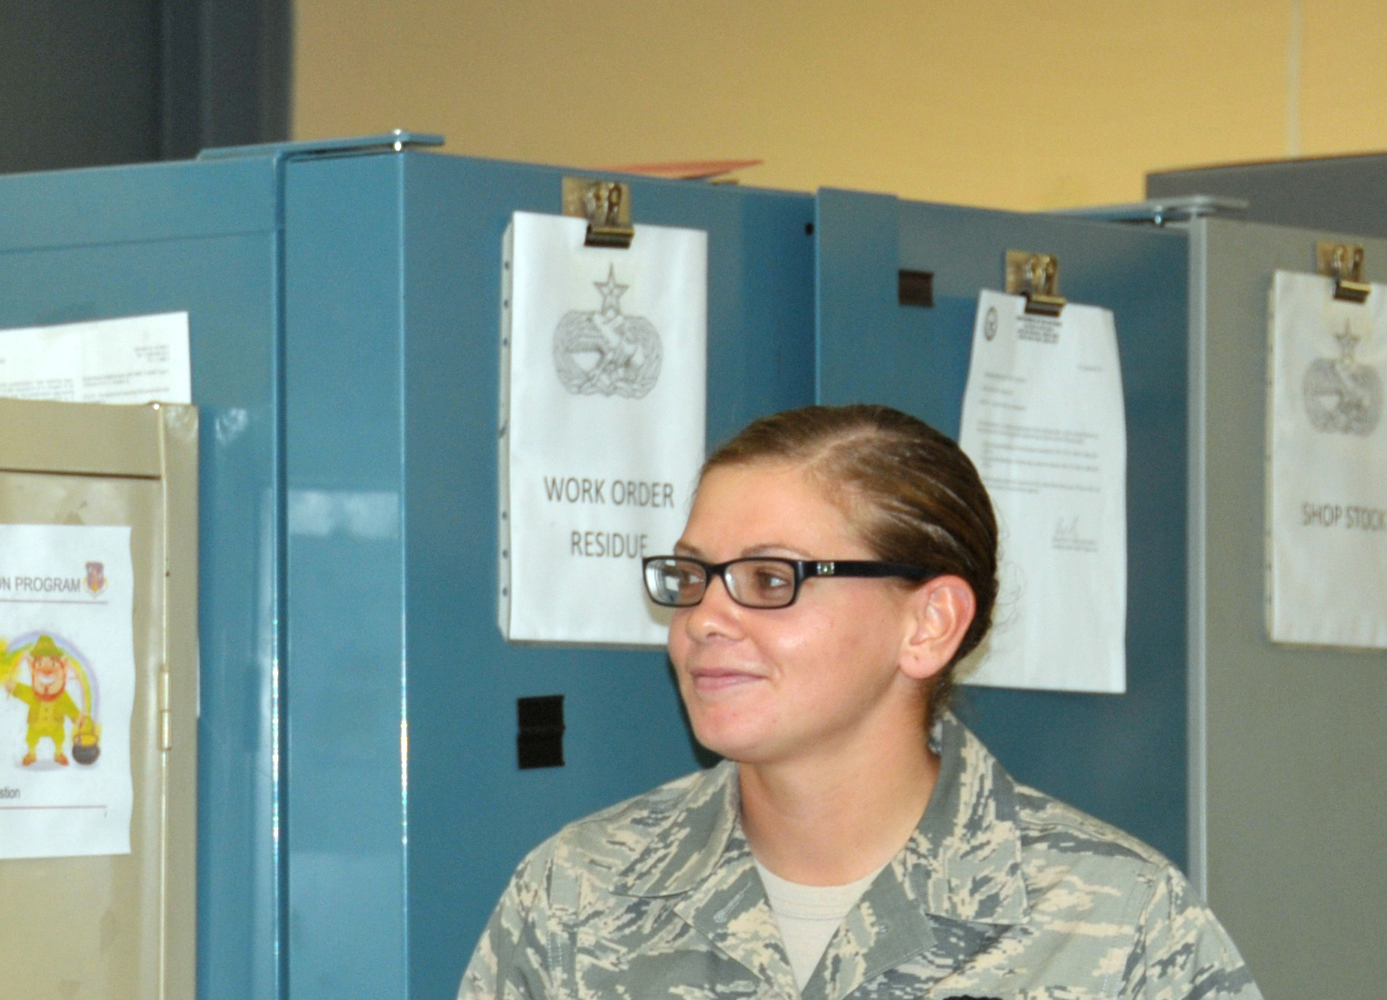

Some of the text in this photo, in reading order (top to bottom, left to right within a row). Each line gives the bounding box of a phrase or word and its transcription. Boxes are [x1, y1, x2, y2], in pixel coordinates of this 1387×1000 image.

[543, 476, 675, 508] WORK ORDER
[1301, 501, 1343, 528] SHOP
[570, 530, 649, 559] RESIDUE
[14, 576, 81, 592] PROGRAM
